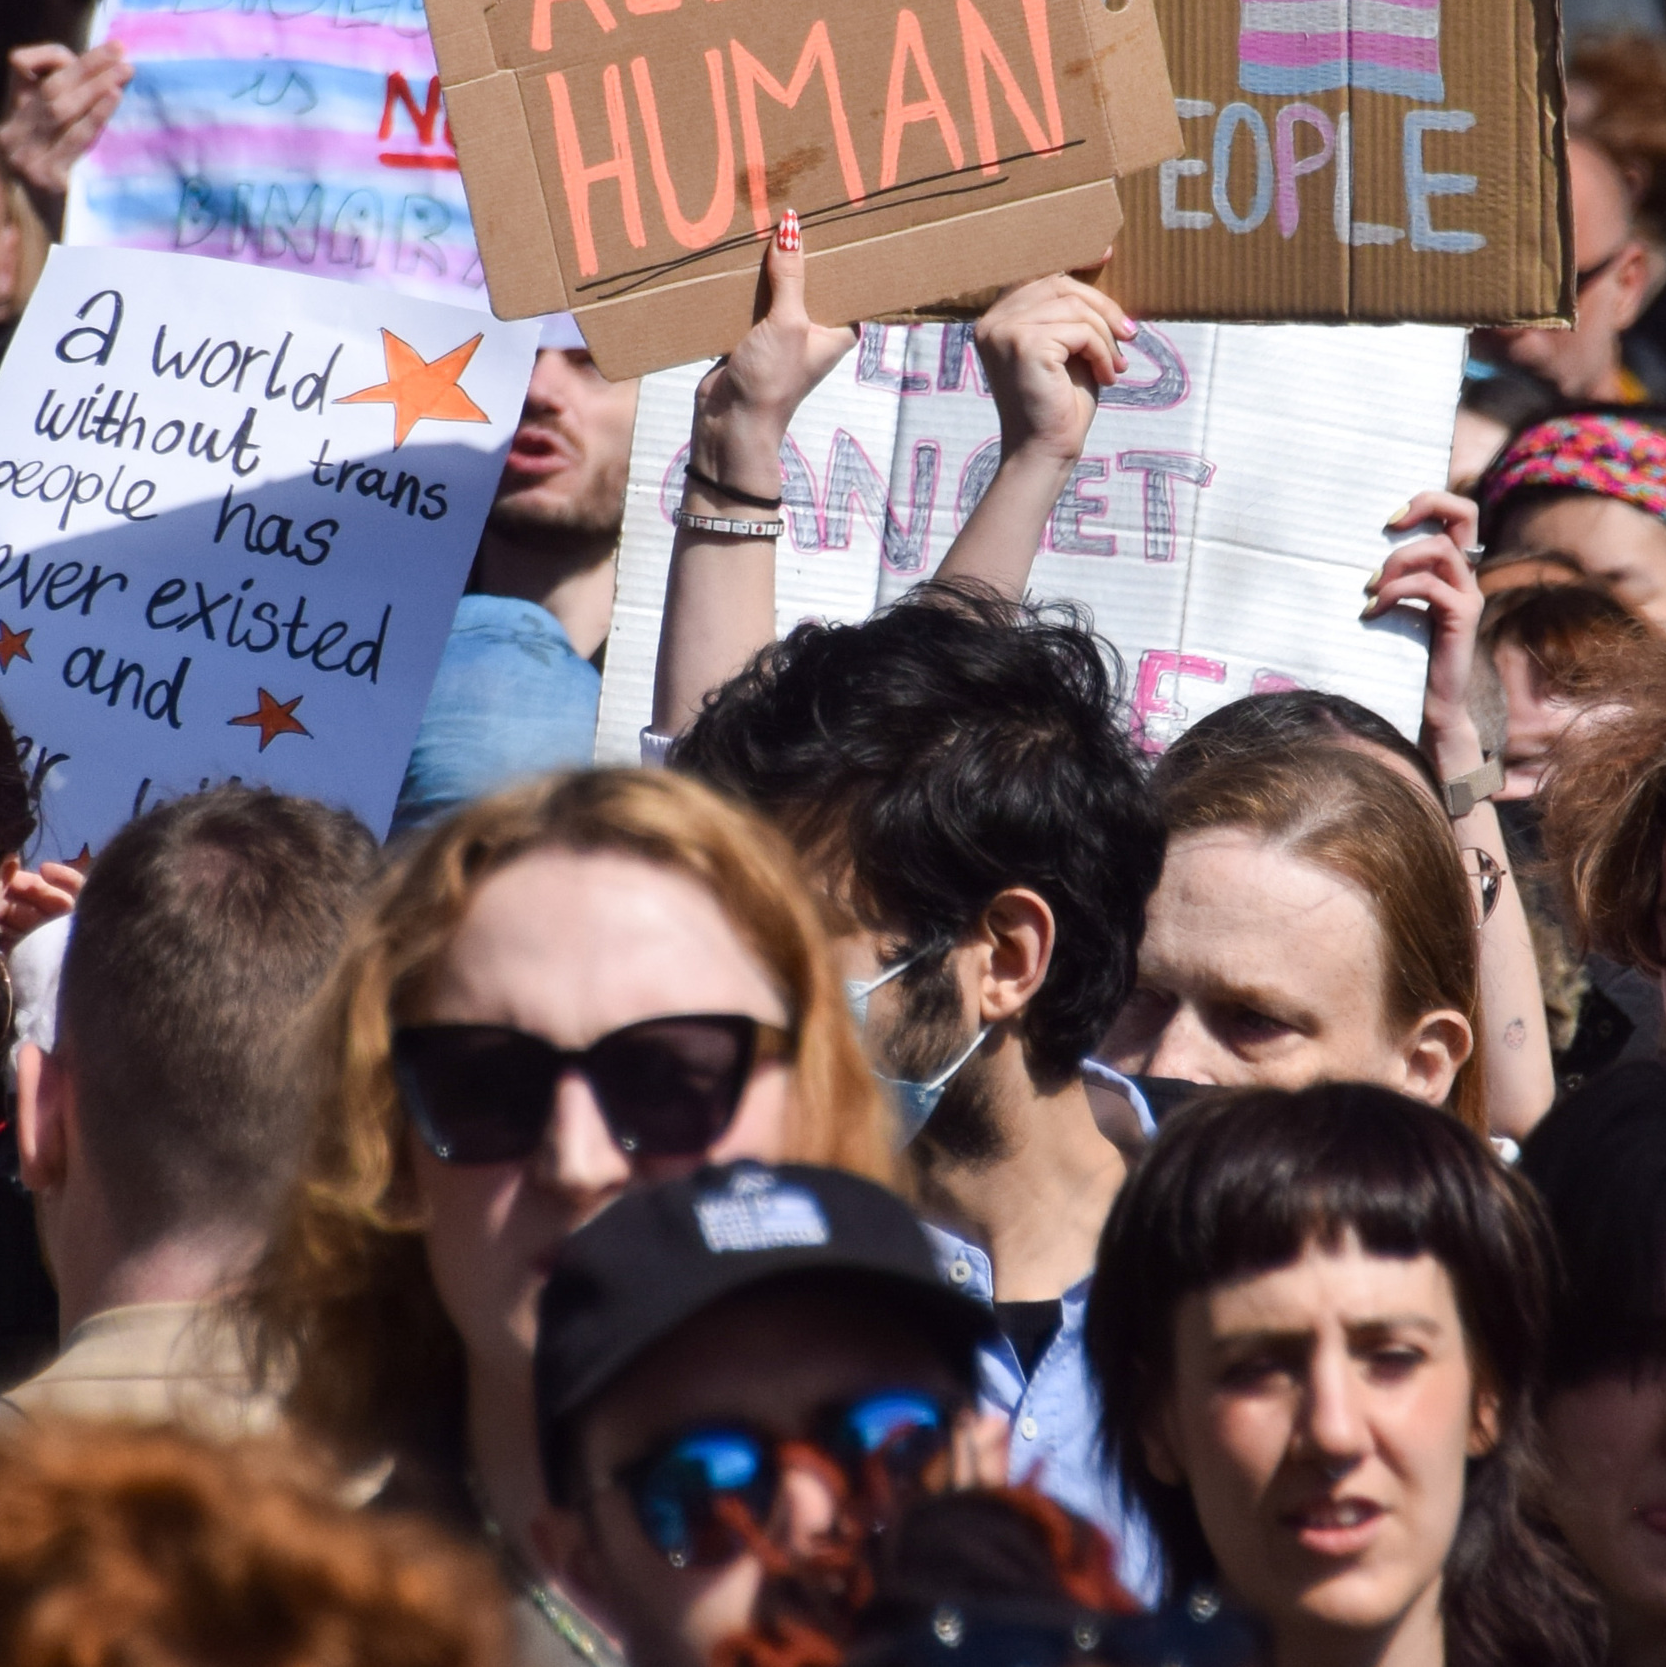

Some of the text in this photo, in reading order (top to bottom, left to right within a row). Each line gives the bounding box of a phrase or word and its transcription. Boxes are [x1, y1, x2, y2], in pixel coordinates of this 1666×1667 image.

[234, 52, 319, 115] is
[1157, 100, 1488, 254] EOPLE
[55, 289, 345, 416] a world
[33, 384, 449, 521] without trans
[214, 483, 340, 567] has
[144, 577, 393, 684] existed
[62, 645, 193, 731] and
